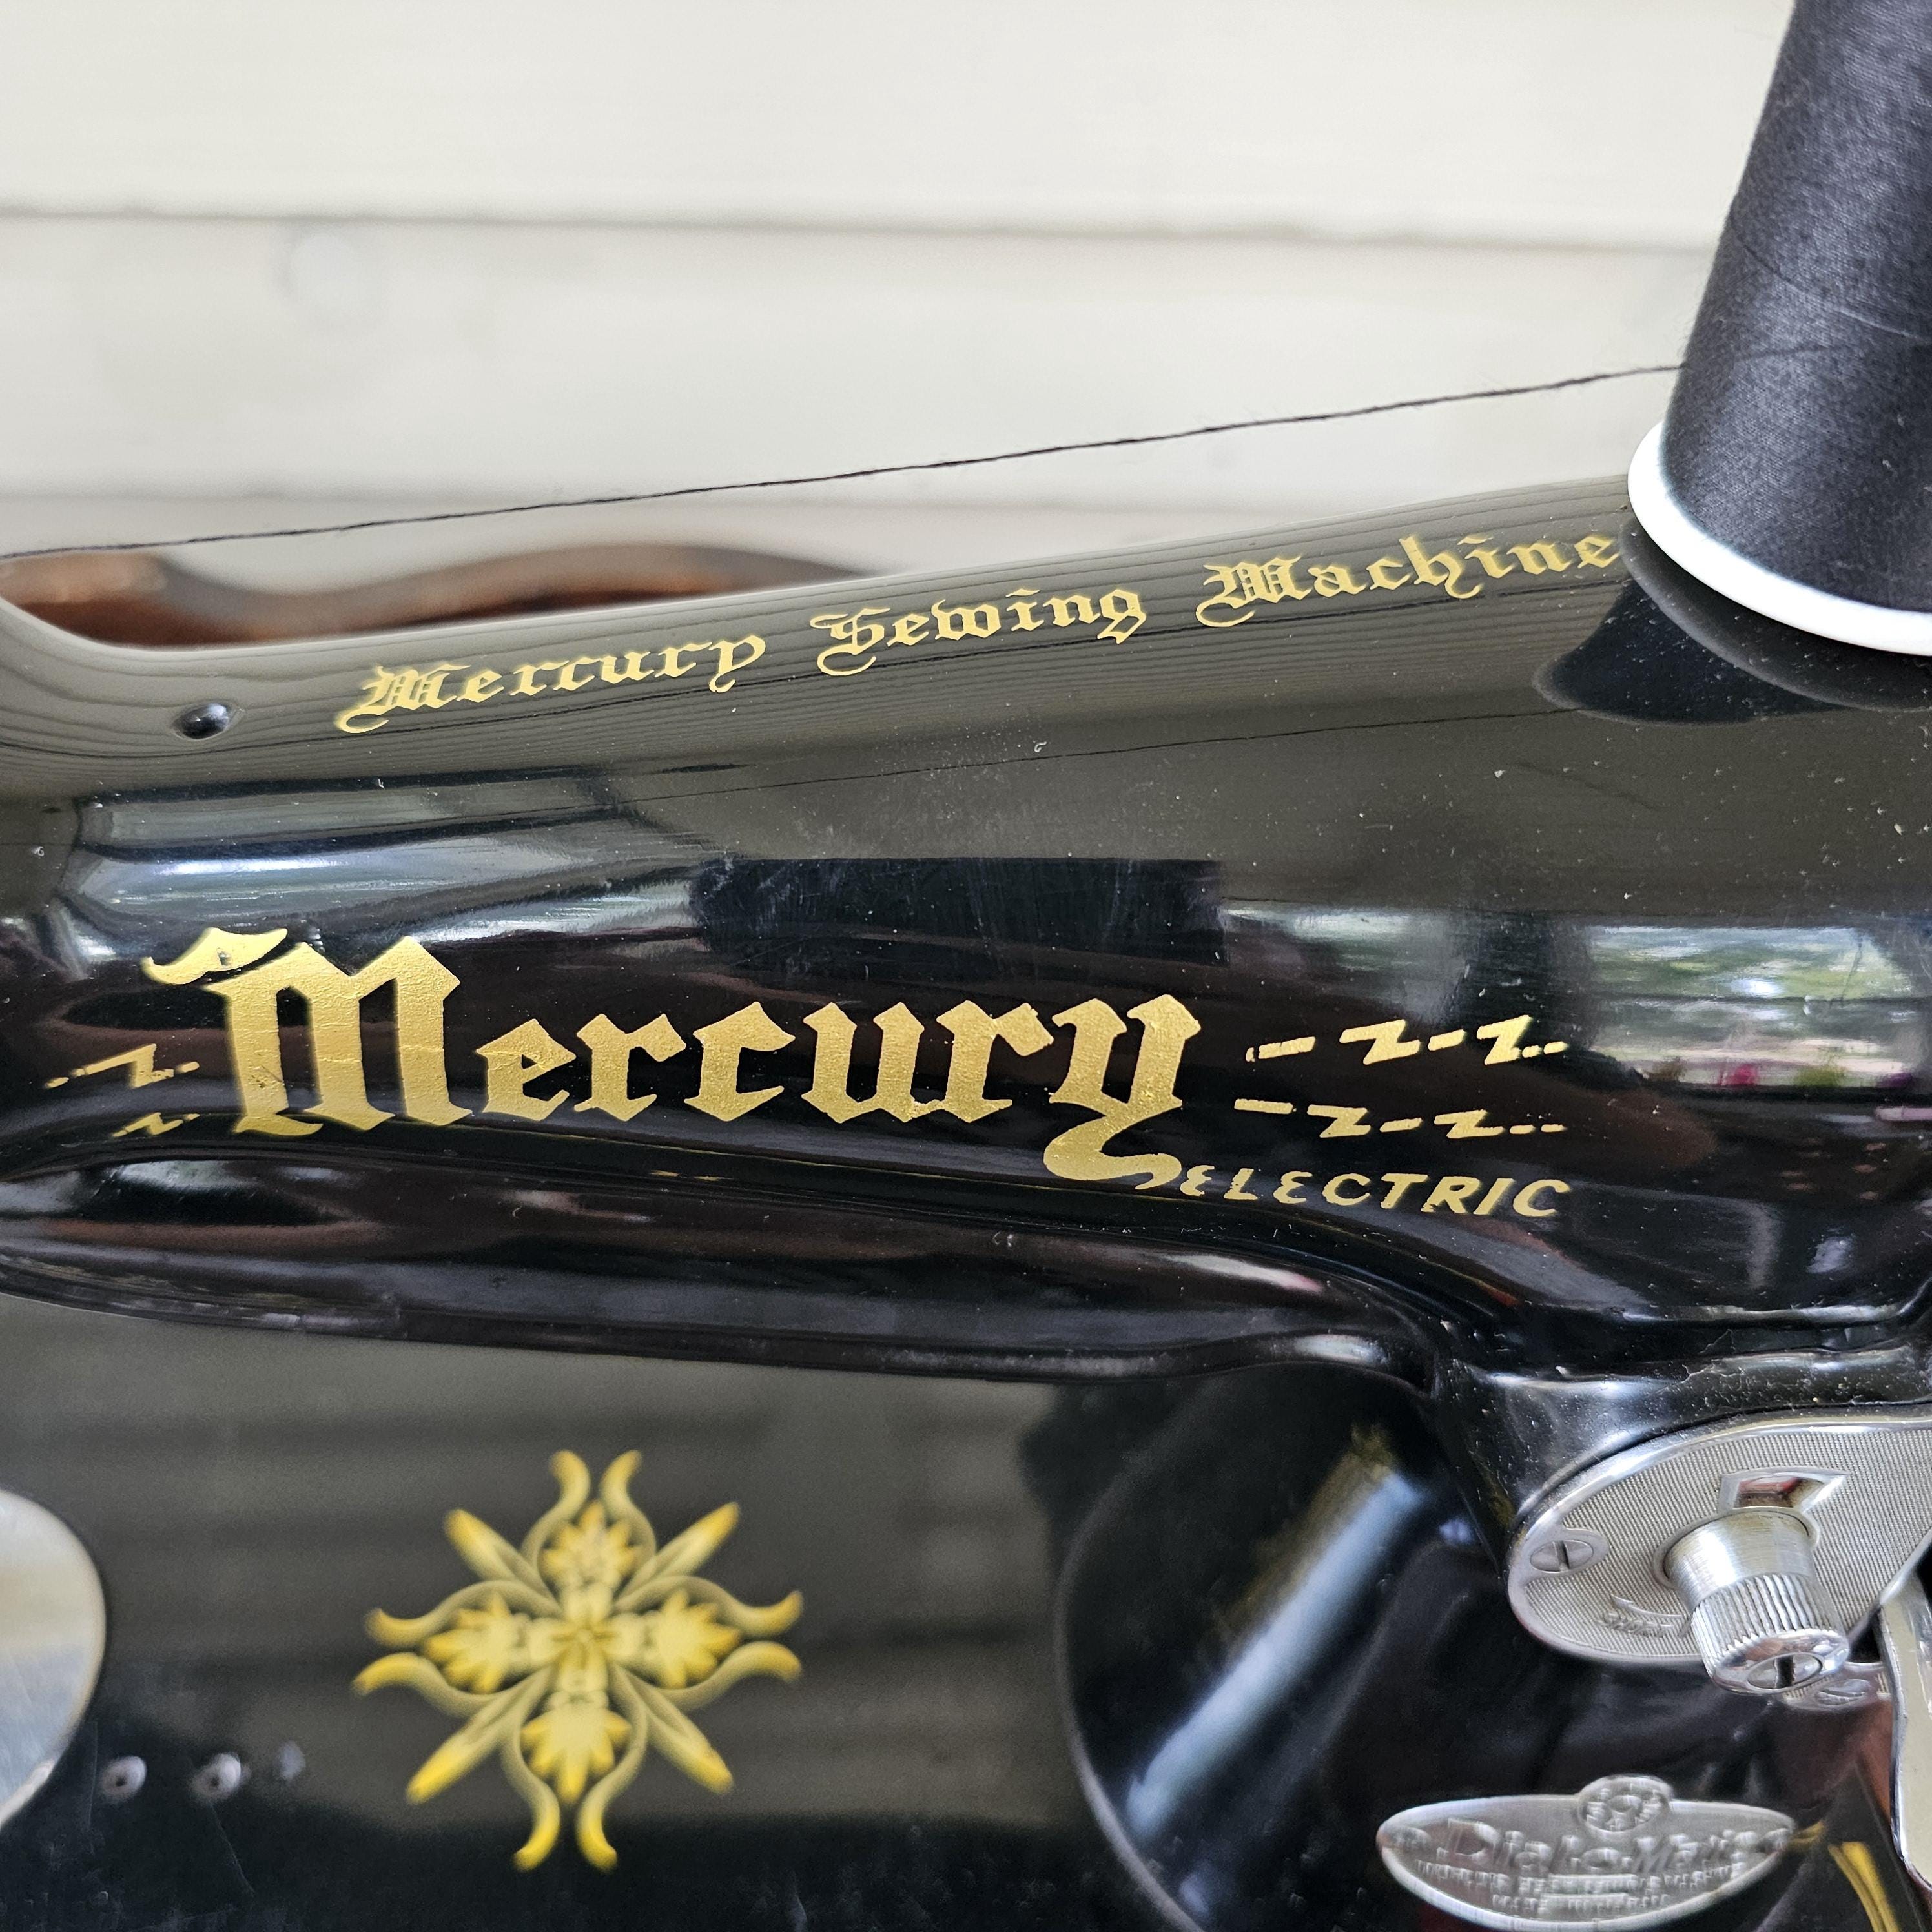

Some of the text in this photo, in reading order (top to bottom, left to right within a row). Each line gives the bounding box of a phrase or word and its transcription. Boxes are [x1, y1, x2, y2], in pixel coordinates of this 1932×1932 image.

[335, 533, 1619, 733] Mercury Sewing Machine
[142, 927, 1202, 1190] Mercury
[1179, 1165, 1571, 1218] ELECTRIC
